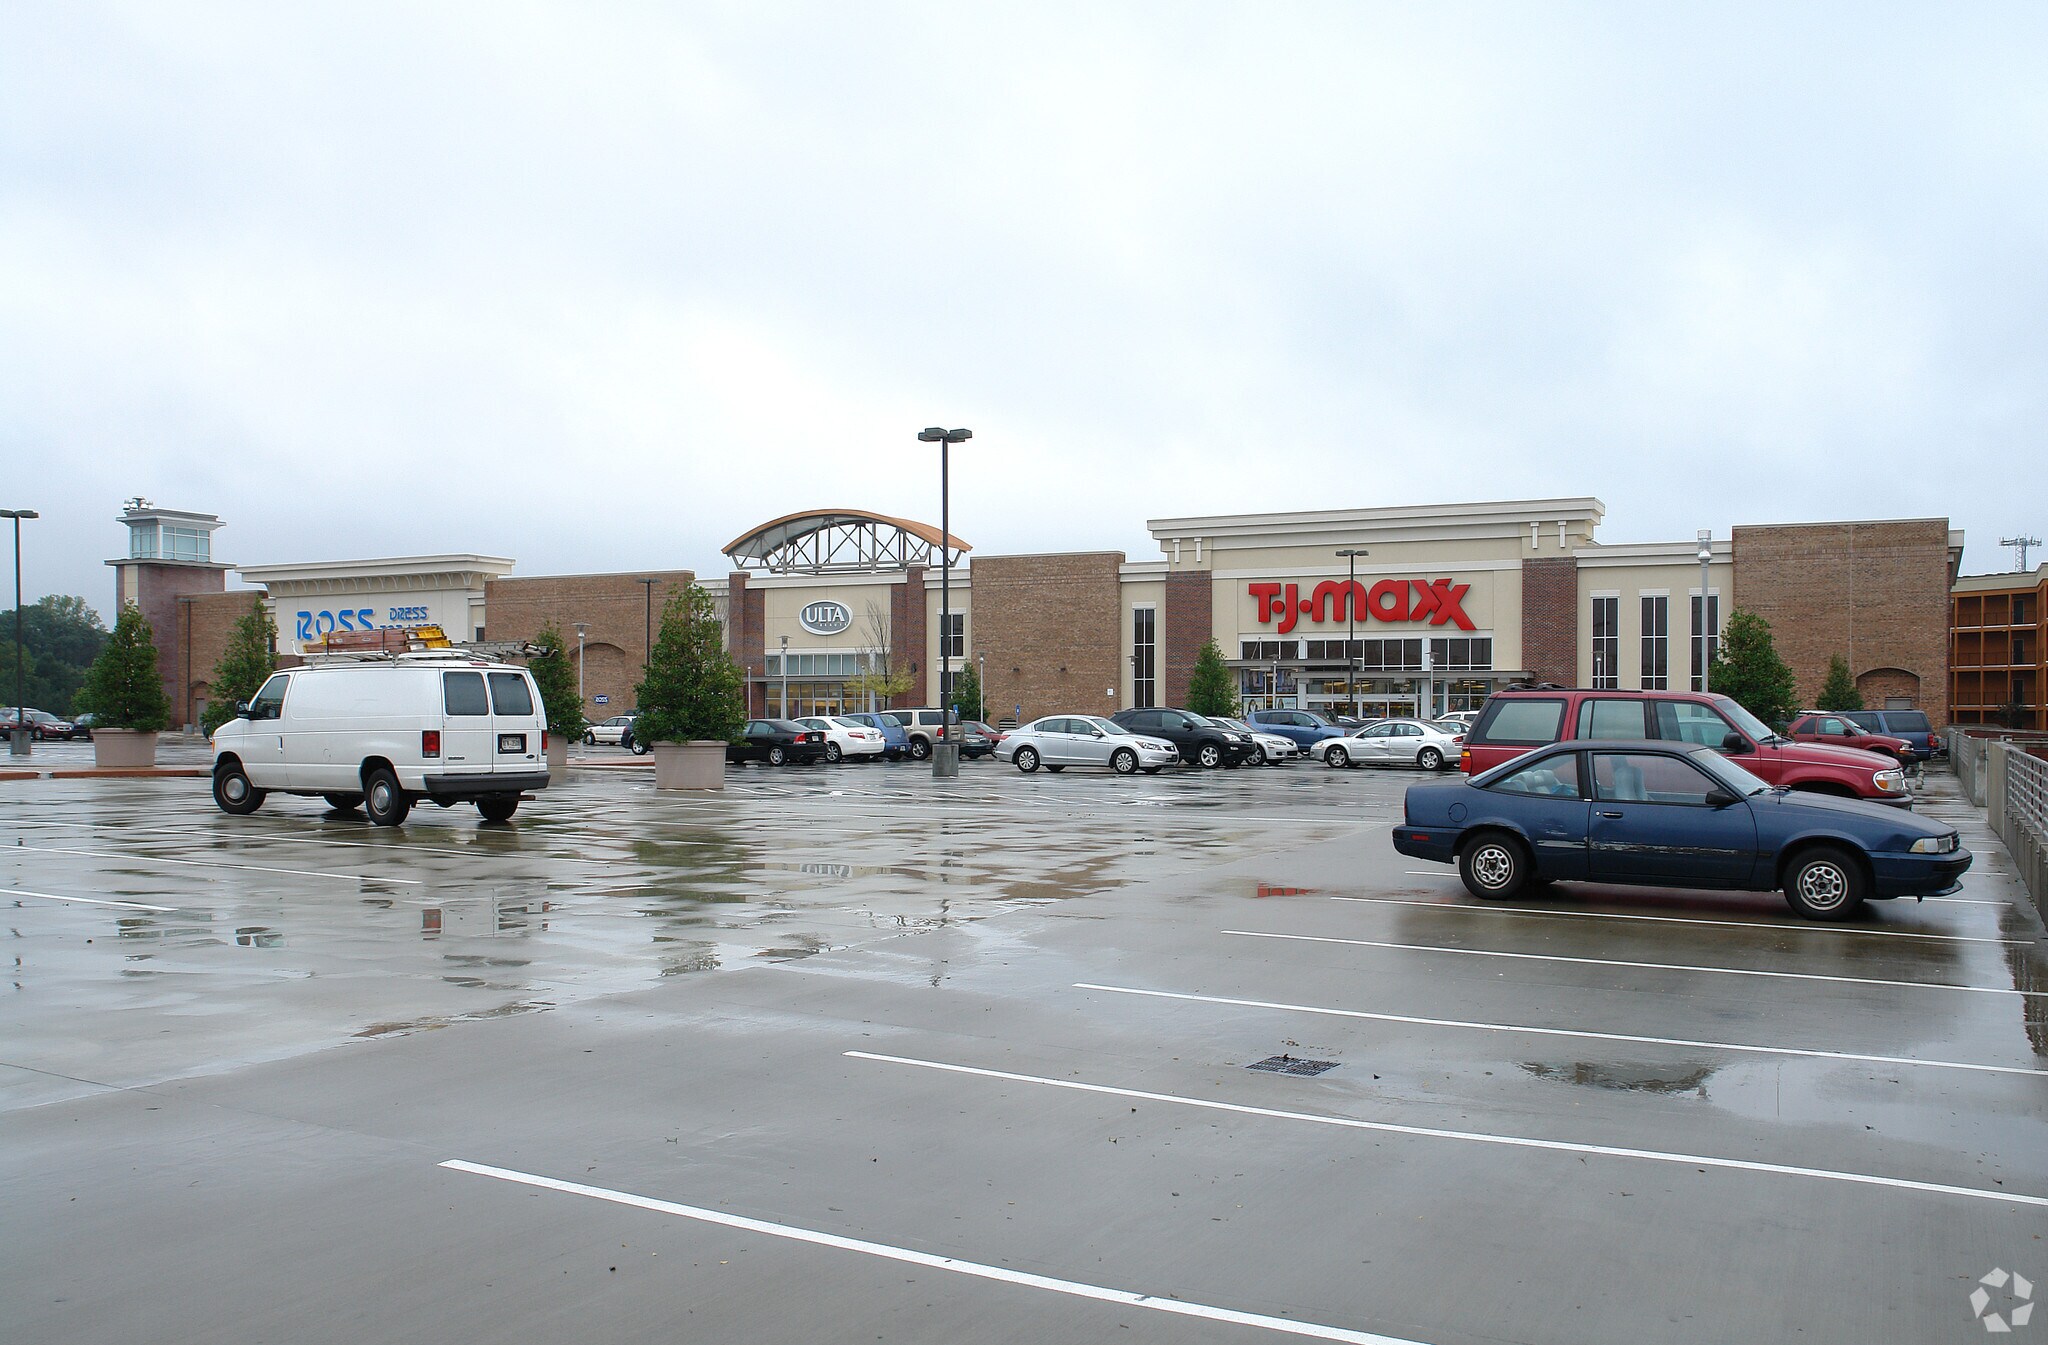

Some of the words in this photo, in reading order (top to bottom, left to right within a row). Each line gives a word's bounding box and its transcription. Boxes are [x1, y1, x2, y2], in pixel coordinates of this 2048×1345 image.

[389, 606, 427, 621] DRESS
[806, 606, 845, 623] ULTA
[296, 608, 374, 640] ROSS
